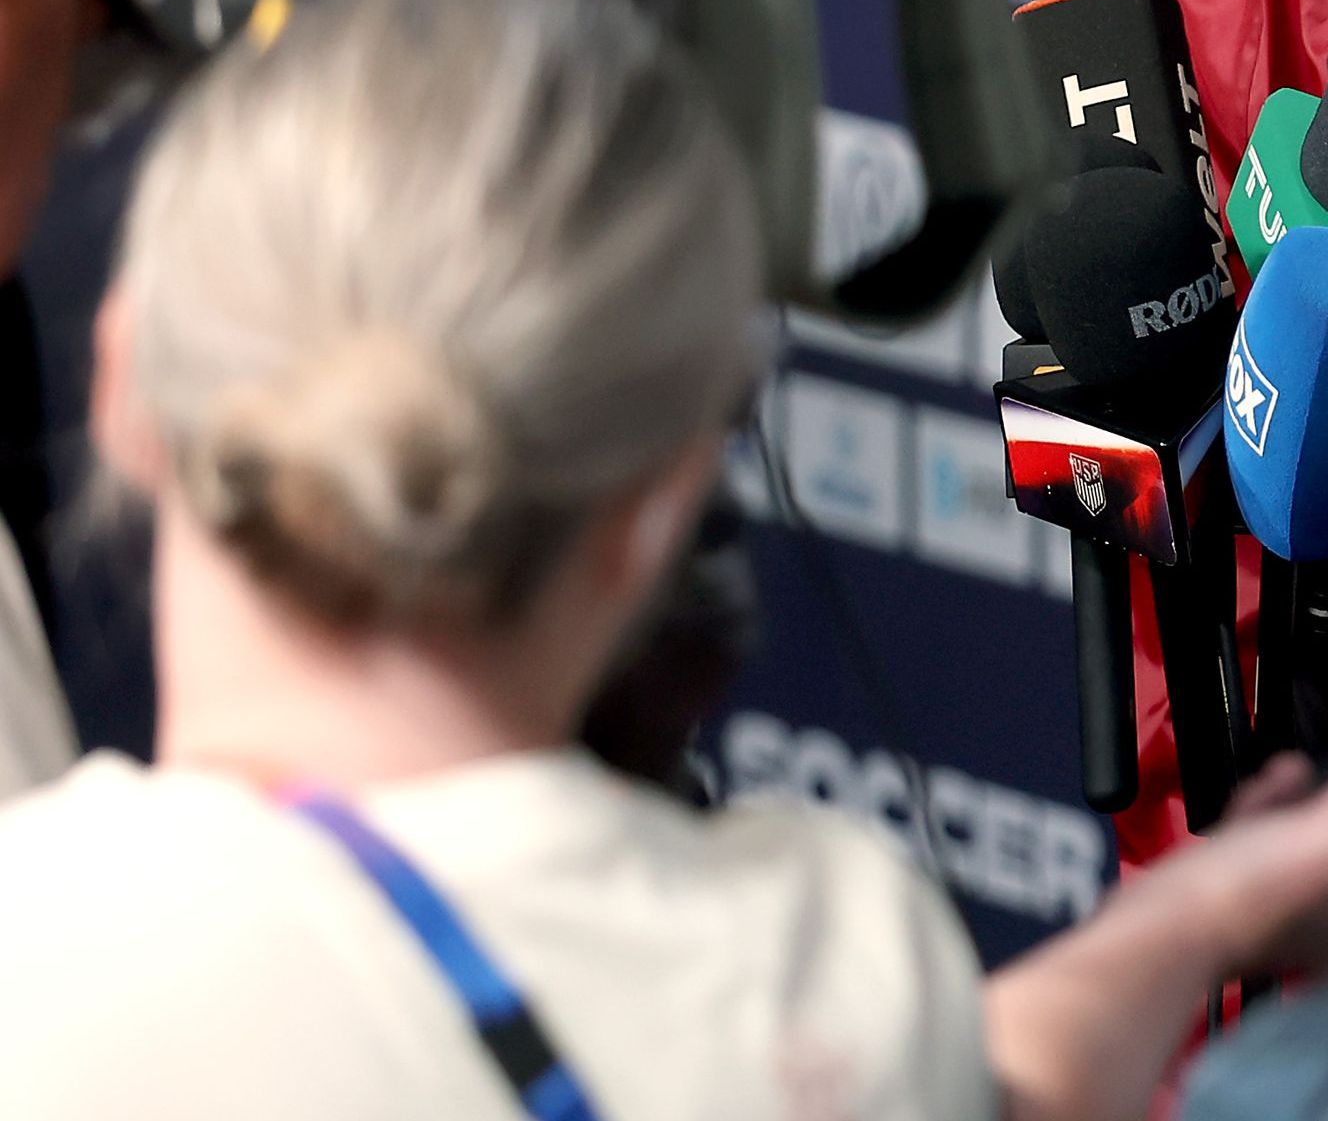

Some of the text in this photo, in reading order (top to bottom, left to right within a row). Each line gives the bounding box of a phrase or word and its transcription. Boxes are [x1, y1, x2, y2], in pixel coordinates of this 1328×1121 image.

[1128, 263, 1223, 339] RØD
[1229, 353, 1266, 437] OX
[1072, 457, 1101, 482] USA
